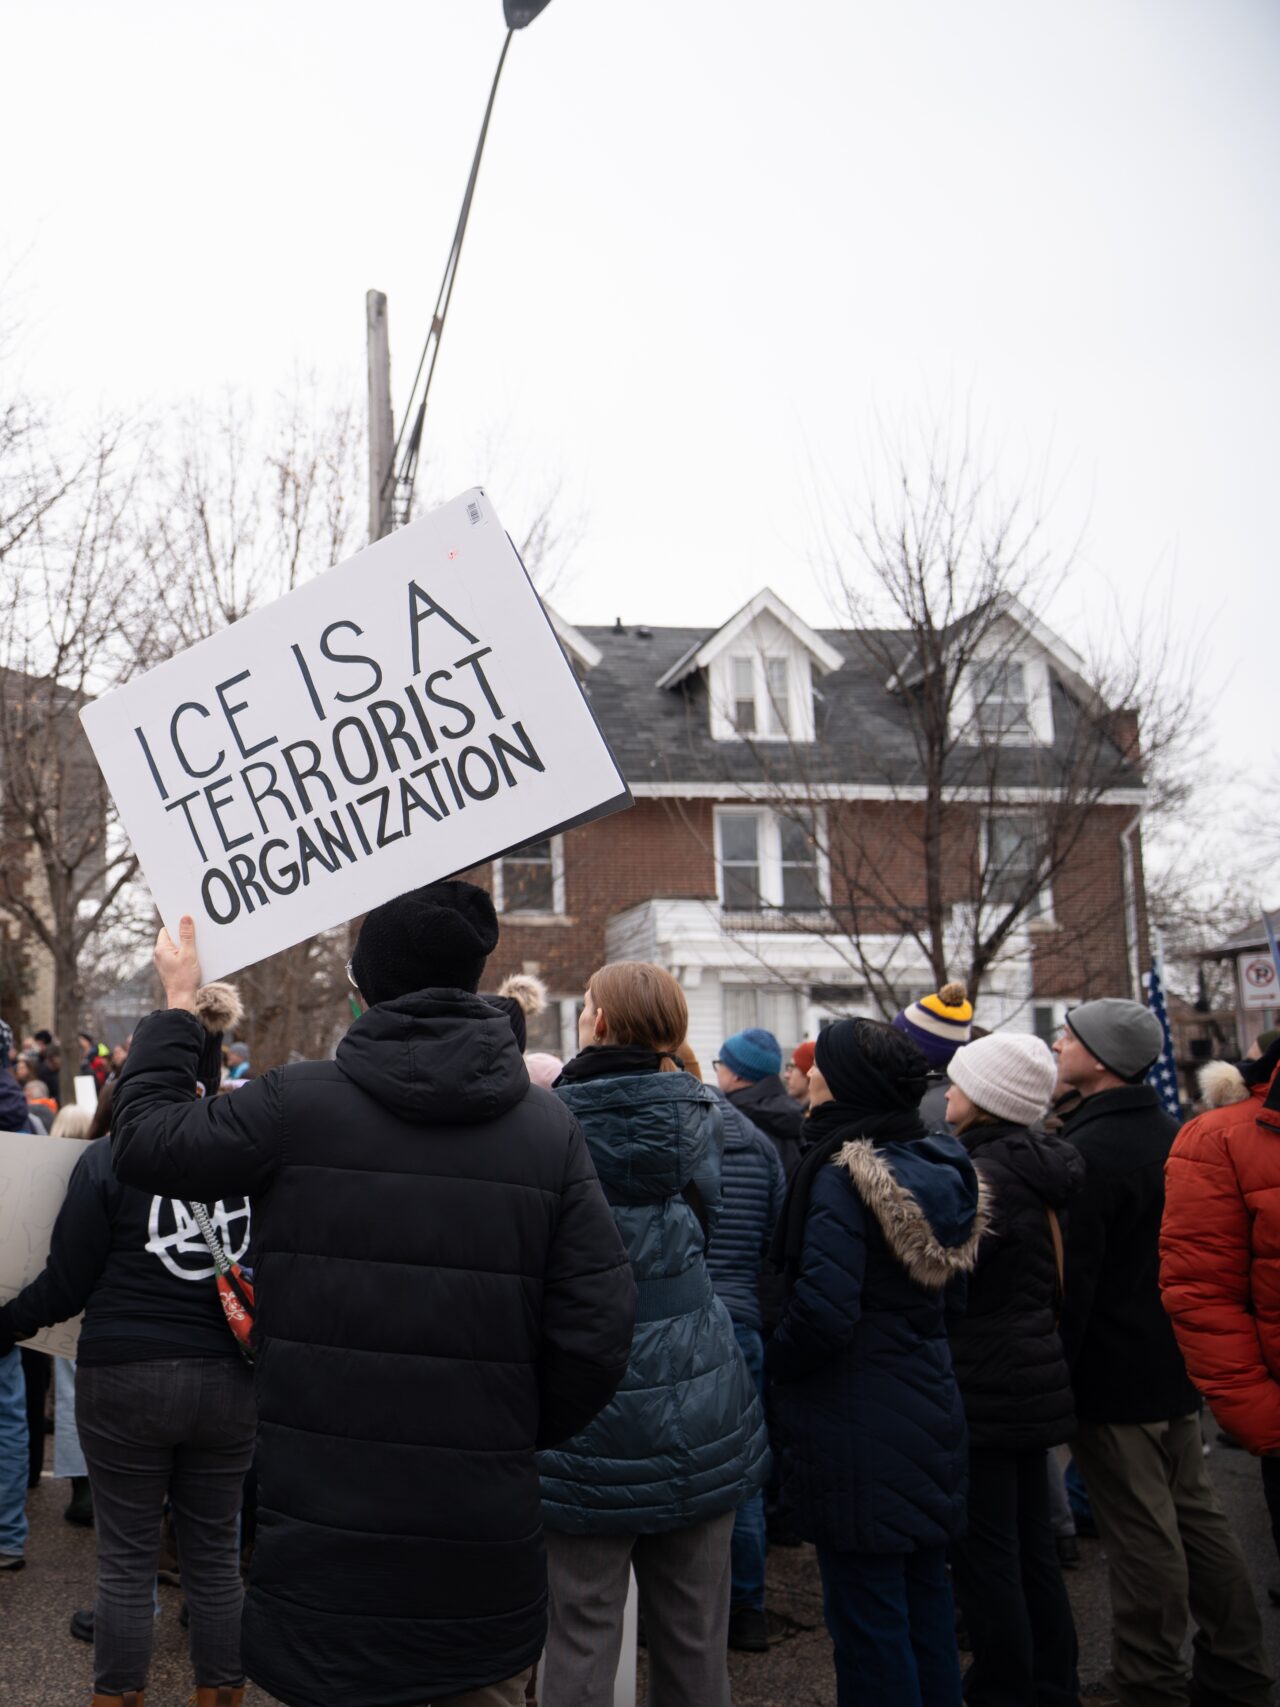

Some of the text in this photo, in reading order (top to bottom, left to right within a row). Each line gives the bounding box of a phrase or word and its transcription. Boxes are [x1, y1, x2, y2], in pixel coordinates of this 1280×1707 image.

[135, 580, 480, 801] ICE IS A
[165, 647, 506, 863] TERRORIST
[201, 721, 546, 926] ORGANIZATION
